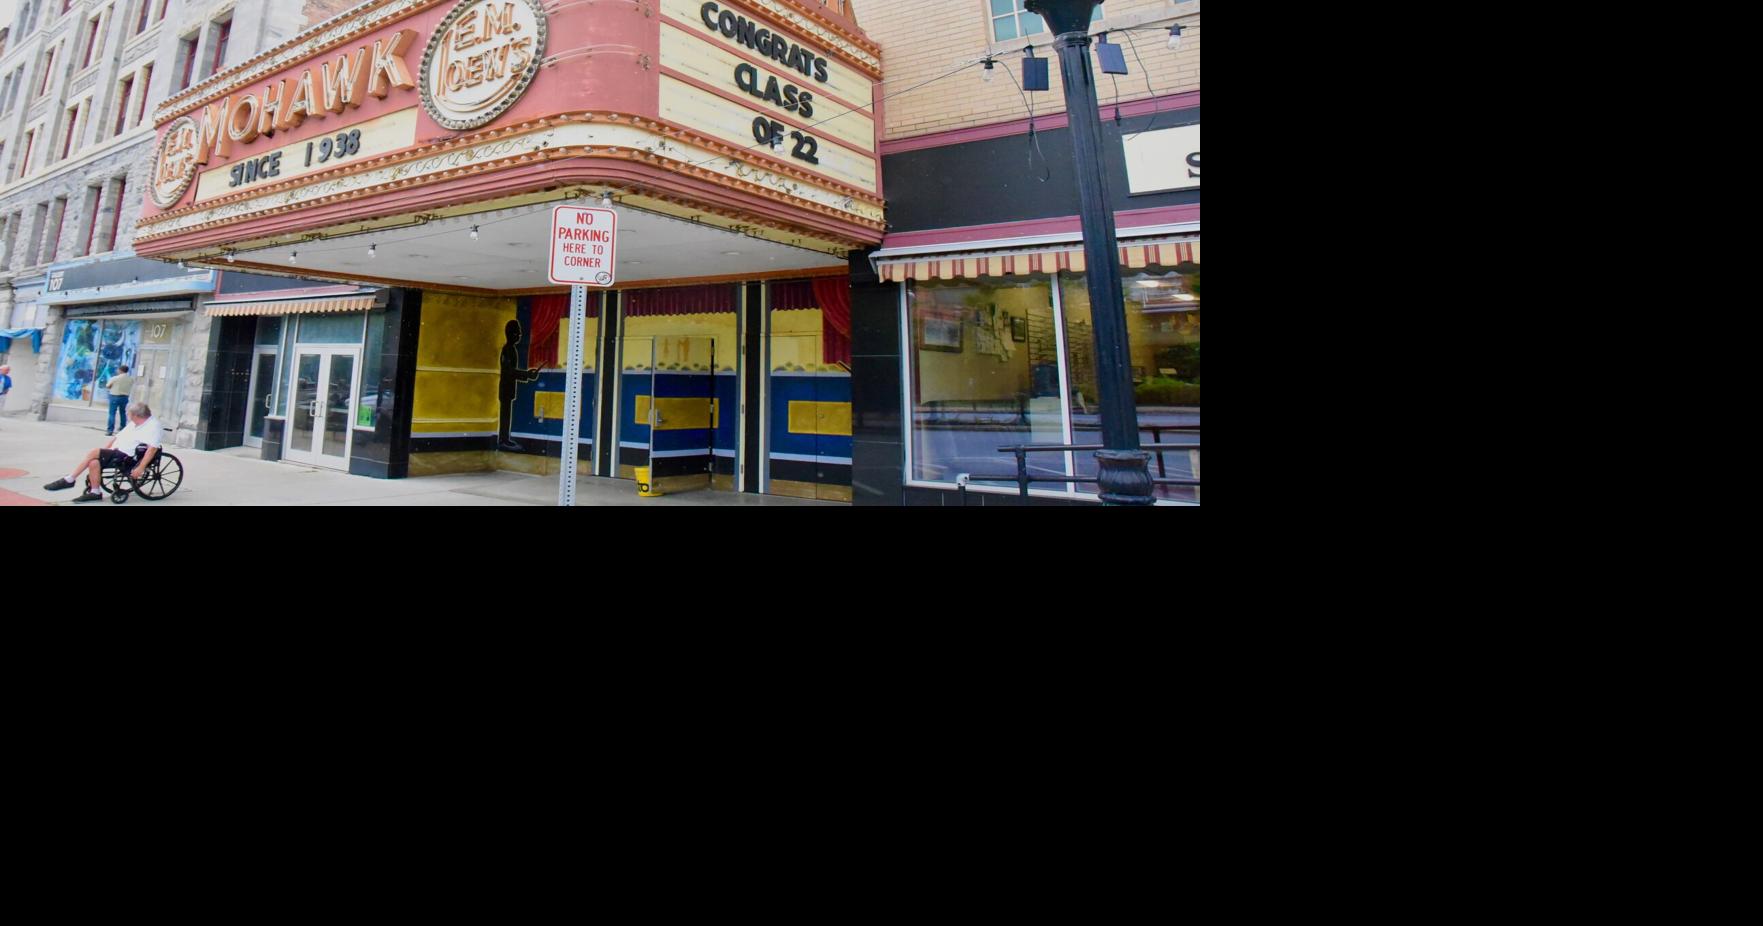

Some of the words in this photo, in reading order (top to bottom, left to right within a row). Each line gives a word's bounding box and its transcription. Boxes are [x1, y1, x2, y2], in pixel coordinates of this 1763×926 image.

[454, 2, 521, 51] E.M.
[701, 2, 828, 83] CONGRATS
[195, 29, 418, 165] MOHAWK
[734, 63, 813, 118] CLASS
[752, 116, 785, 149] OF
[791, 131, 819, 165] 22
[228, 151, 283, 187] SINCE
[304, 129, 361, 167] 1938
[577, 212, 594, 225] NO
[558, 227, 609, 243] PARKING
[563, 243, 586, 254] HERE
[592, 244, 604, 255] TO
[564, 255, 601, 268] CORNER
[49, 277, 64, 291] 107
[152, 324, 166, 338] 107
